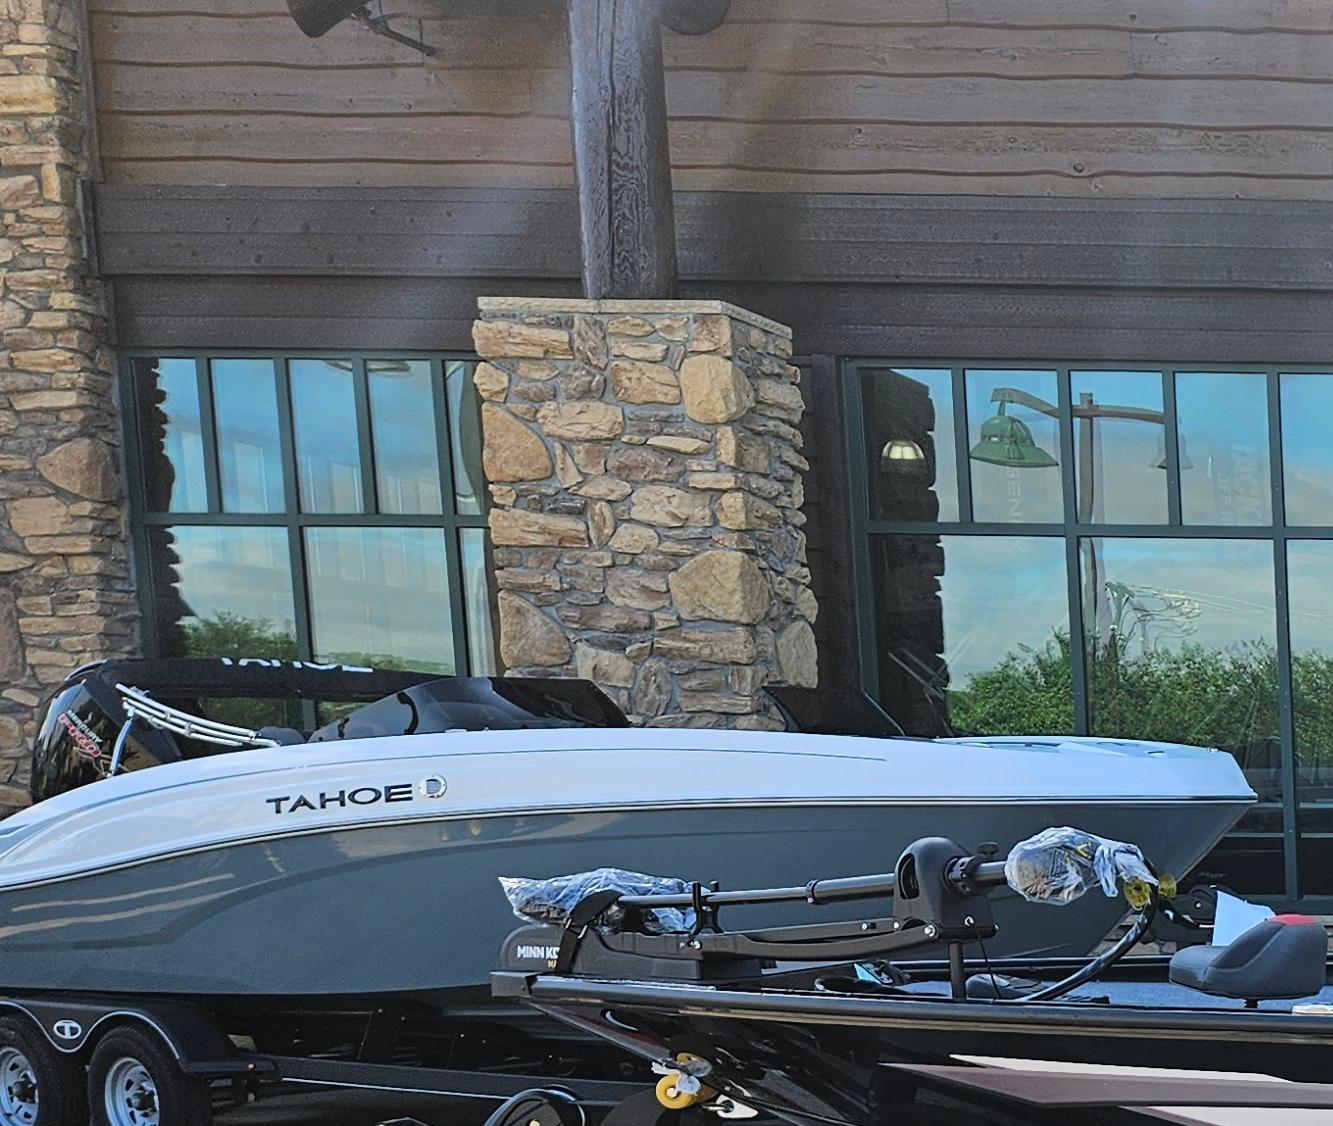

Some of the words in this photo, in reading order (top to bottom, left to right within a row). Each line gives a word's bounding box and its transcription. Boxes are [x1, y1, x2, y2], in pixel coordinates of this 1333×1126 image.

[66, 709, 104, 743] MERCURY
[265, 783, 413, 815] TAHOE
[517, 945, 545, 959] MINN
